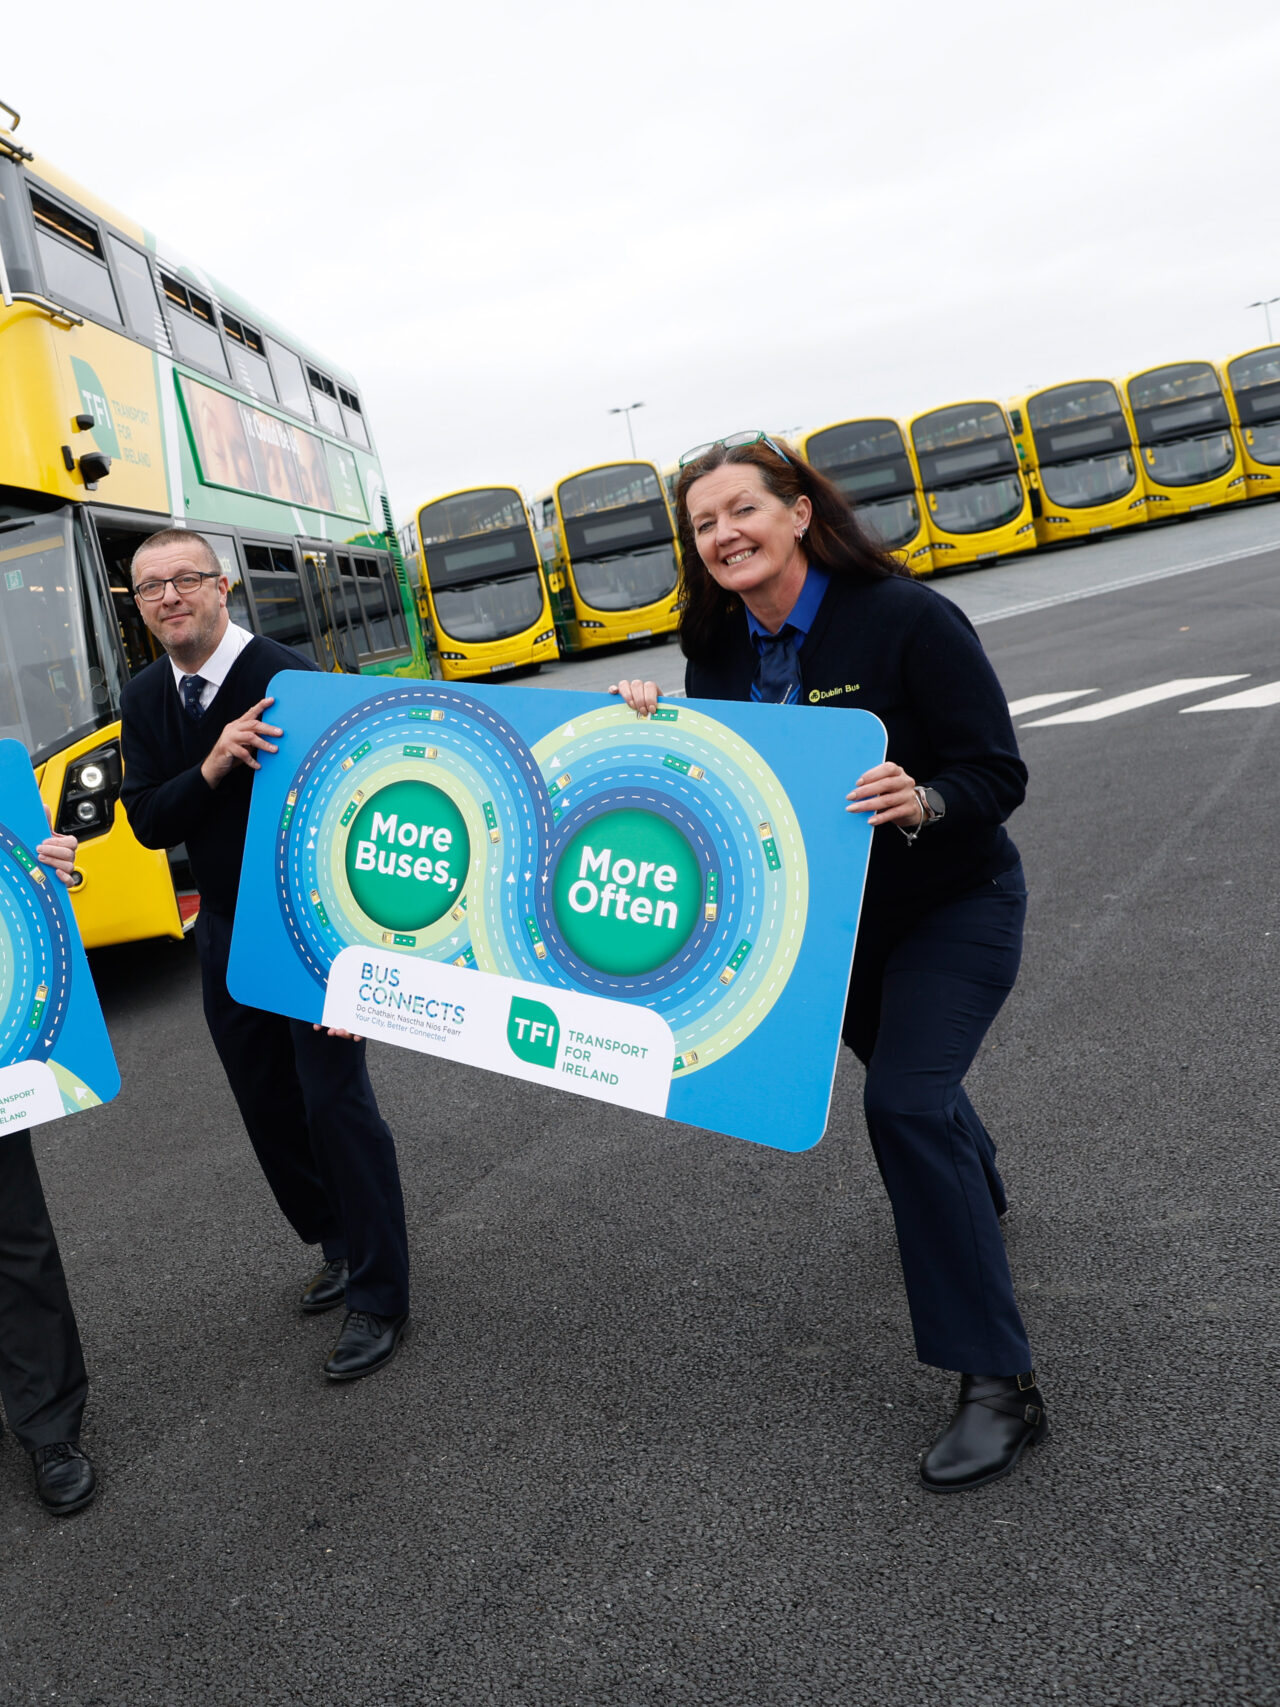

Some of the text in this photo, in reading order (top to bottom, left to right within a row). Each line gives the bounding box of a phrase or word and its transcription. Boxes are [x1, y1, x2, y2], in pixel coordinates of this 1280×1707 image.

[81, 389, 112, 429] TFI
[821, 683, 860, 699] Dublin Bus
[370, 811, 453, 852] More
[354, 840, 458, 893] Buses,
[578, 845, 678, 893] More
[568, 879, 679, 930] Often
[361, 962, 400, 987] BUS
[359, 983, 465, 1025] CONNECTS
[387, 1021, 408, 1032] Better
[409, 1026, 446, 1042] Connected
[515, 1017, 555, 1047] TFI
[569, 1030, 648, 1059] TRANSPORT
[564, 1046, 592, 1062] FOR
[562, 1061, 619, 1086] IRELAND
